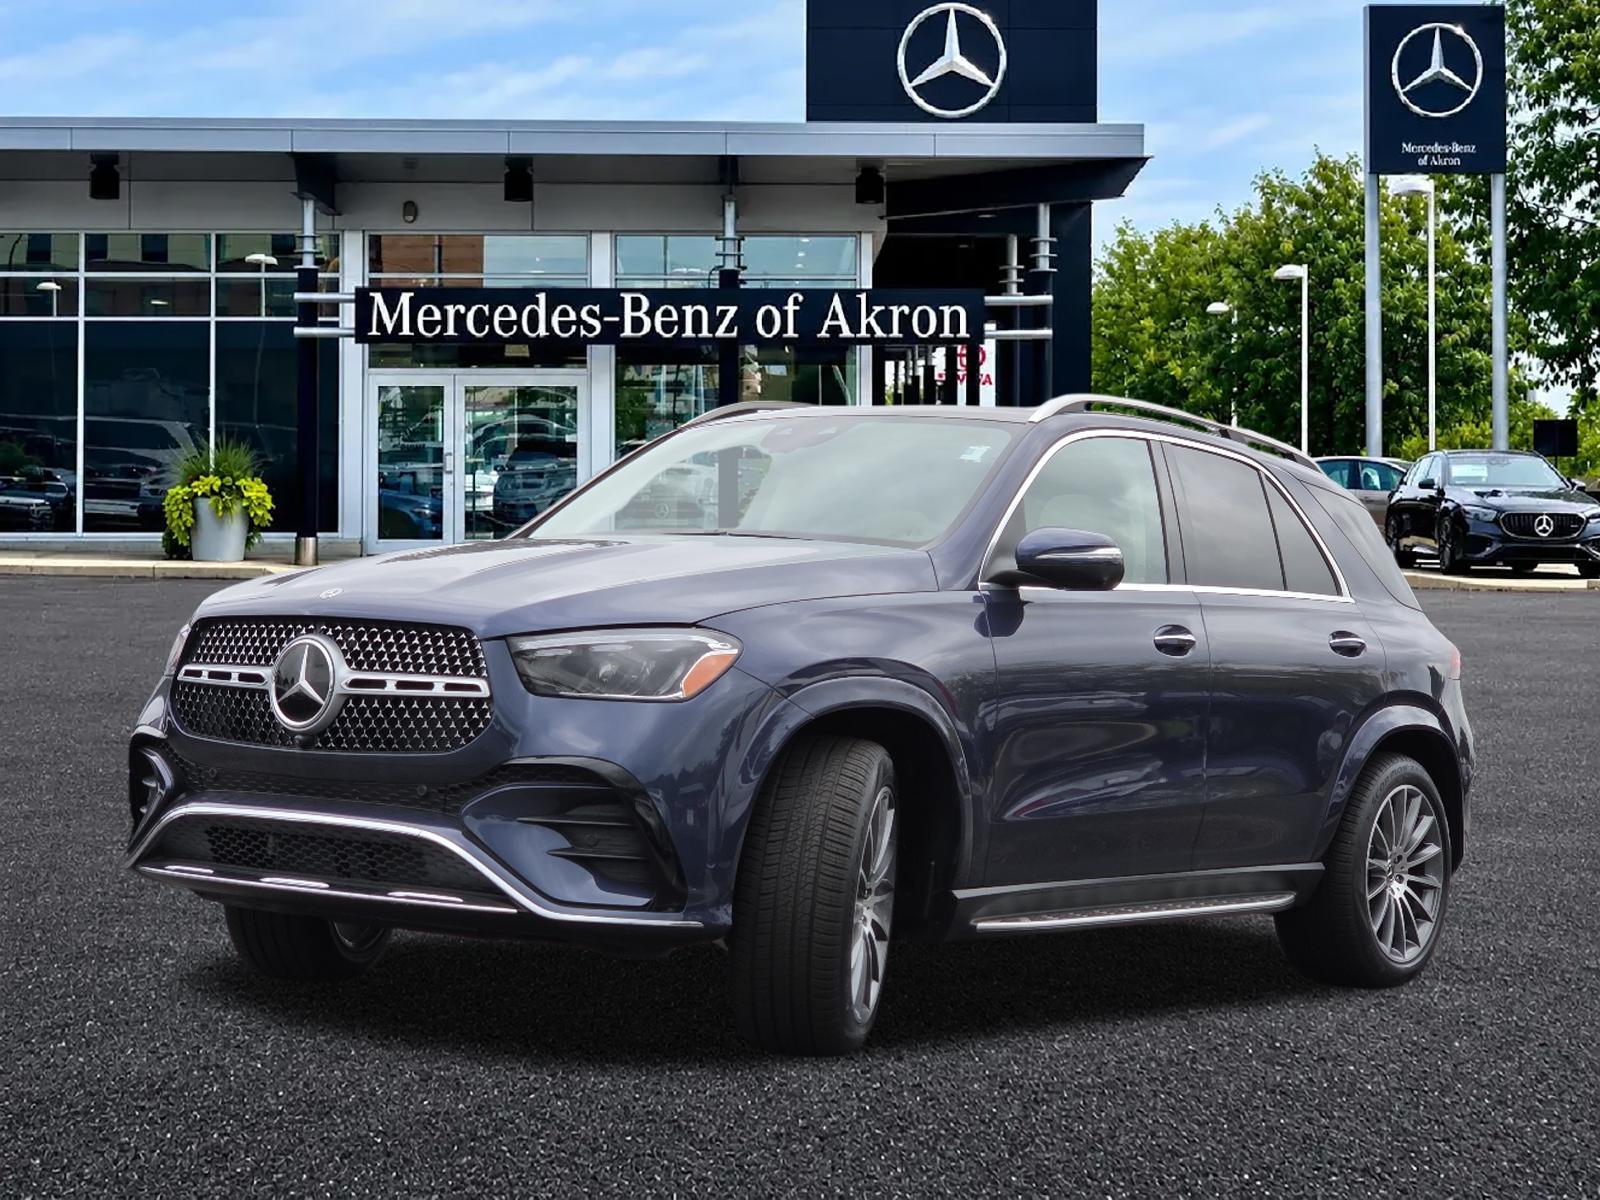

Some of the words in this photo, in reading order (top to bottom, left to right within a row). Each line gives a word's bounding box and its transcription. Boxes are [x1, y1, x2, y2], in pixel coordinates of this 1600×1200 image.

[1401, 141, 1476, 154] Mercedes-Benz
[1417, 154, 1428, 166] of
[1430, 154, 1461, 166] Akron
[368, 291, 738, 338] Mercedes-Benz
[756, 292, 804, 338] of
[817, 291, 971, 338] Akron
